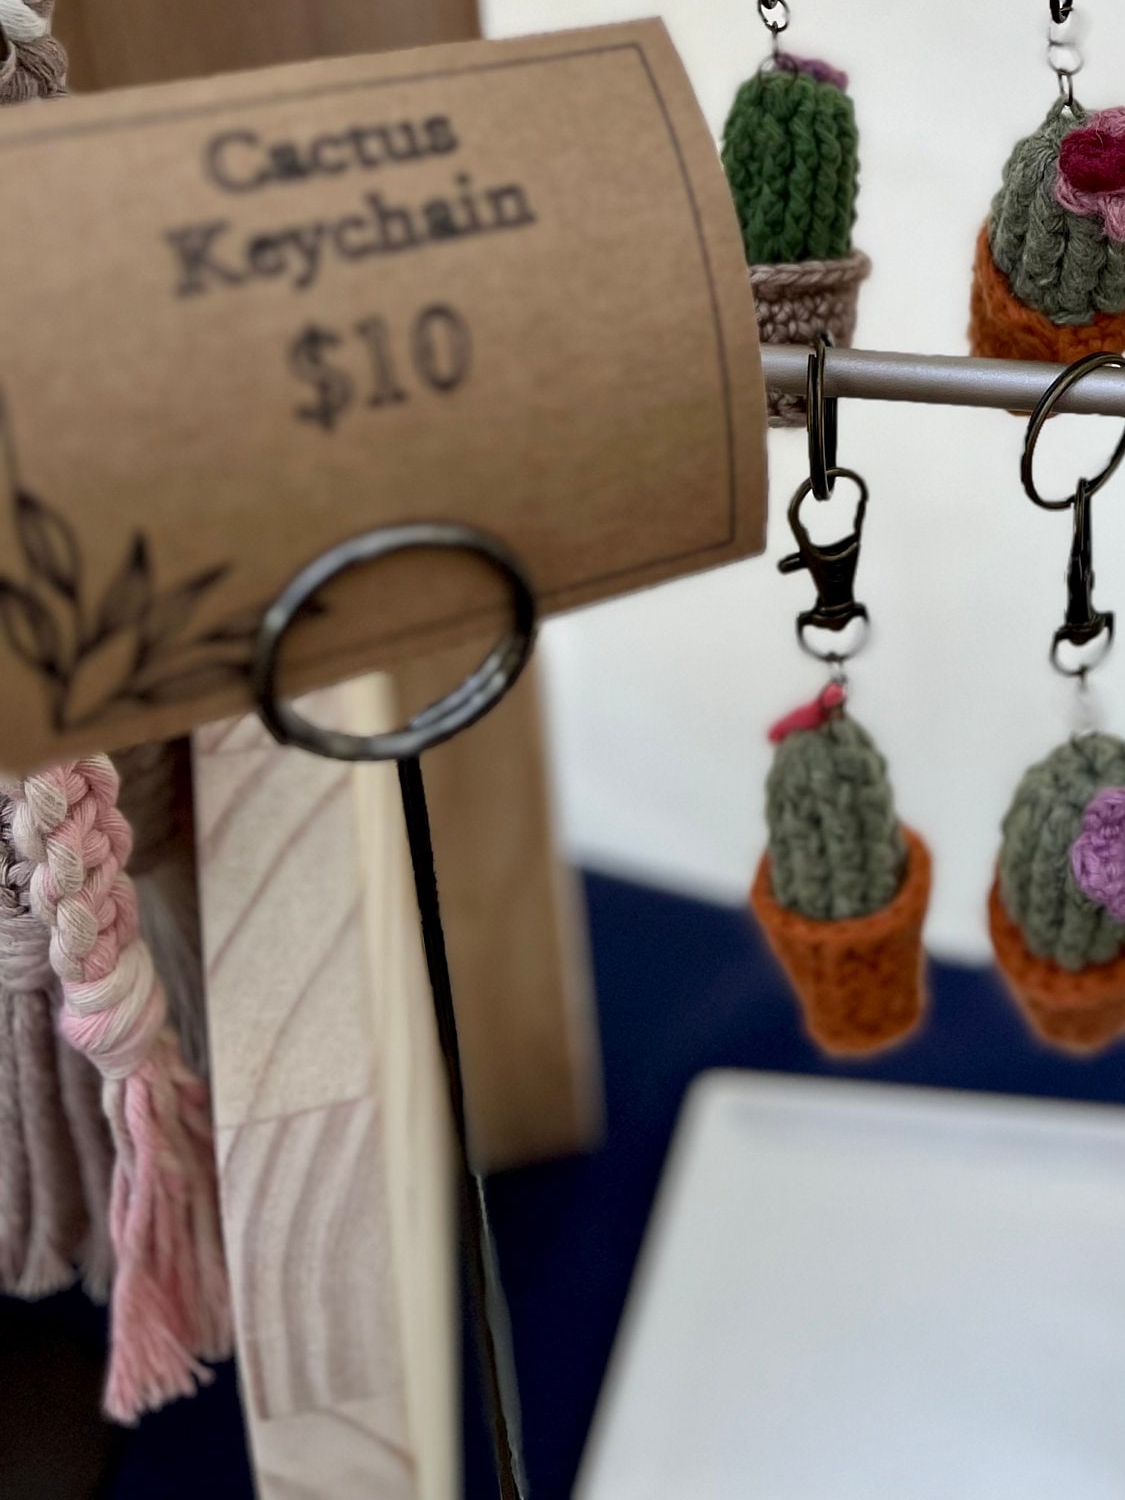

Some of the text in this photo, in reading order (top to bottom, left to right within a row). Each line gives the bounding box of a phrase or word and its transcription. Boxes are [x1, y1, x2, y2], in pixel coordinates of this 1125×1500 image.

[205, 114, 460, 193] Cactus
[164, 173, 537, 297] Keychain
[289, 303, 473, 431] $10
